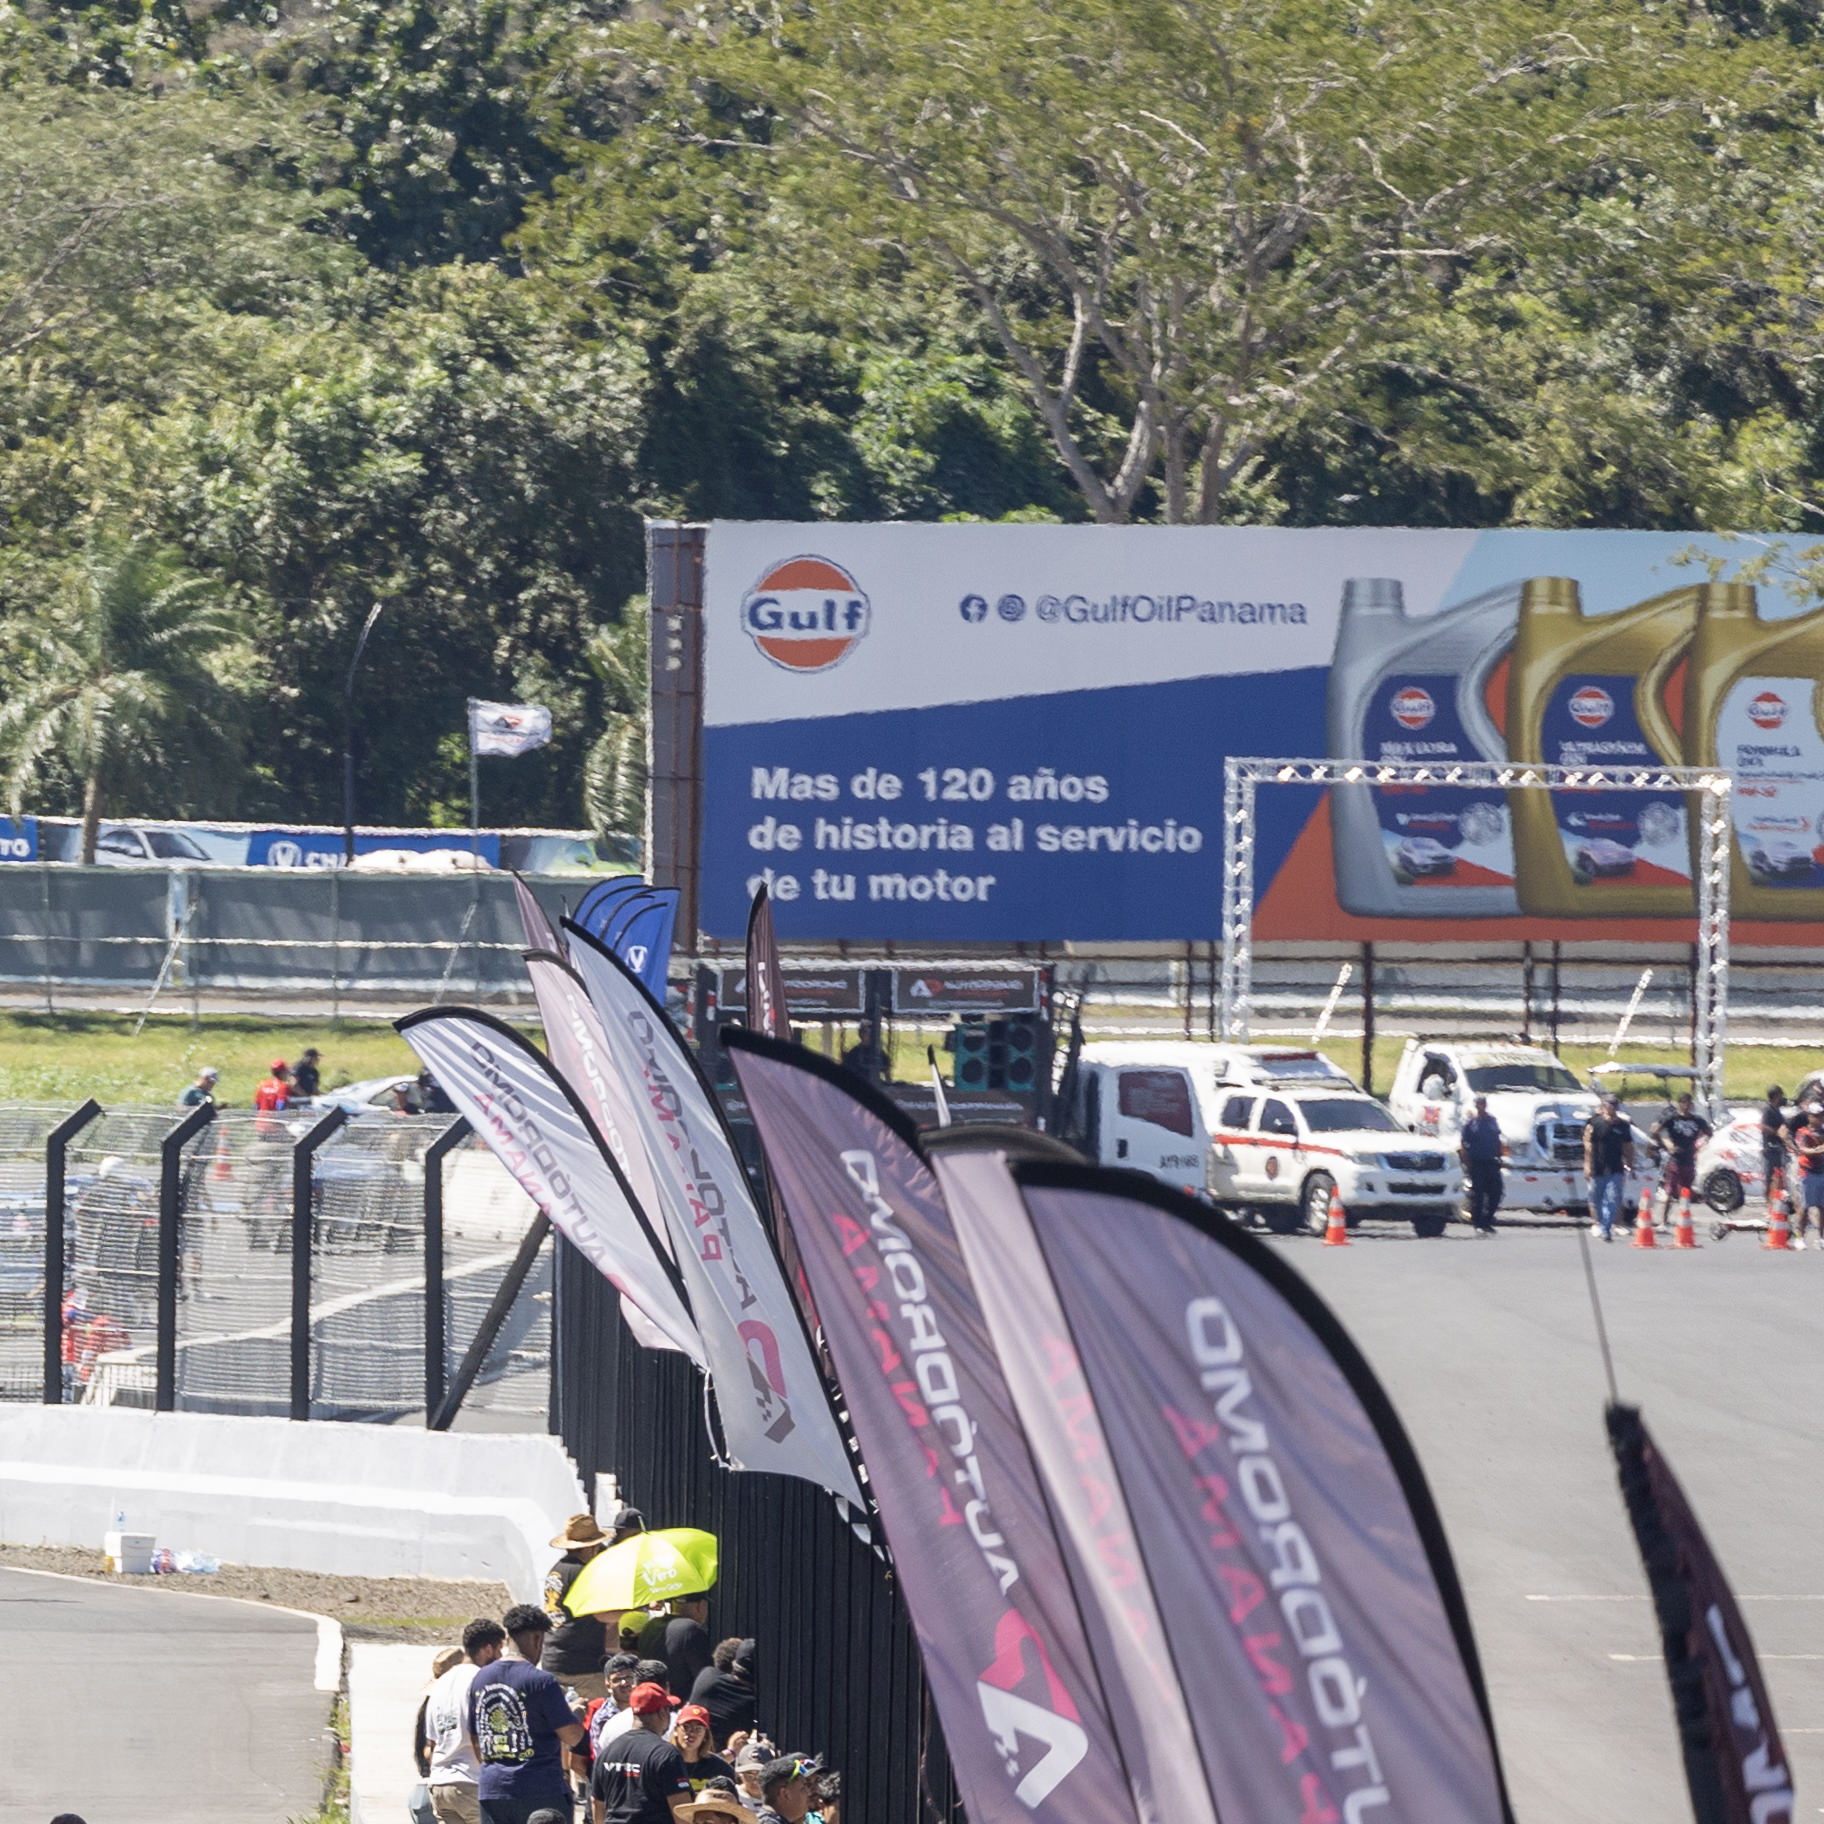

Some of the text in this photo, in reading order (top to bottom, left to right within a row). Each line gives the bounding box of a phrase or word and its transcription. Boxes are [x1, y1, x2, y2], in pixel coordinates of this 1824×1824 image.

[750, 595, 865, 632] Gulf
[1036, 594, 1308, 626] @GulfOilPanama
[751, 766, 1109, 802] Mas de 120 años
[747, 815, 1203, 852] de historia al servicio
[747, 867, 996, 902] de tu motor
